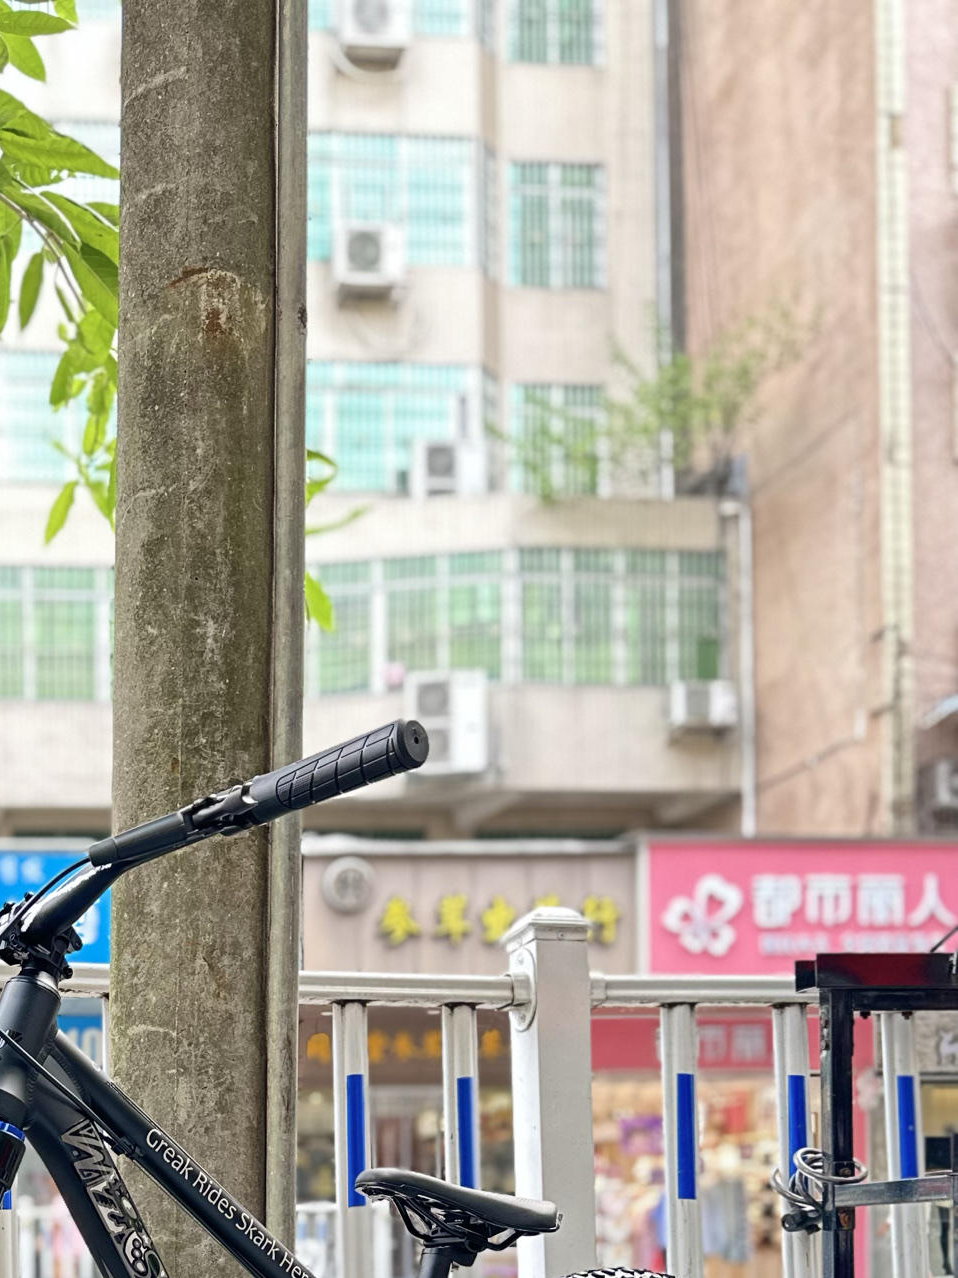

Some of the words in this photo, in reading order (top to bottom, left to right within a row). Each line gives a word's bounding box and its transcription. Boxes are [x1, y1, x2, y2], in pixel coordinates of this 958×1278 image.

[145, 1128, 193, 1181] Greak
[192, 1171, 236, 1220] Rides
[235, 1212, 281, 1262] Skark
